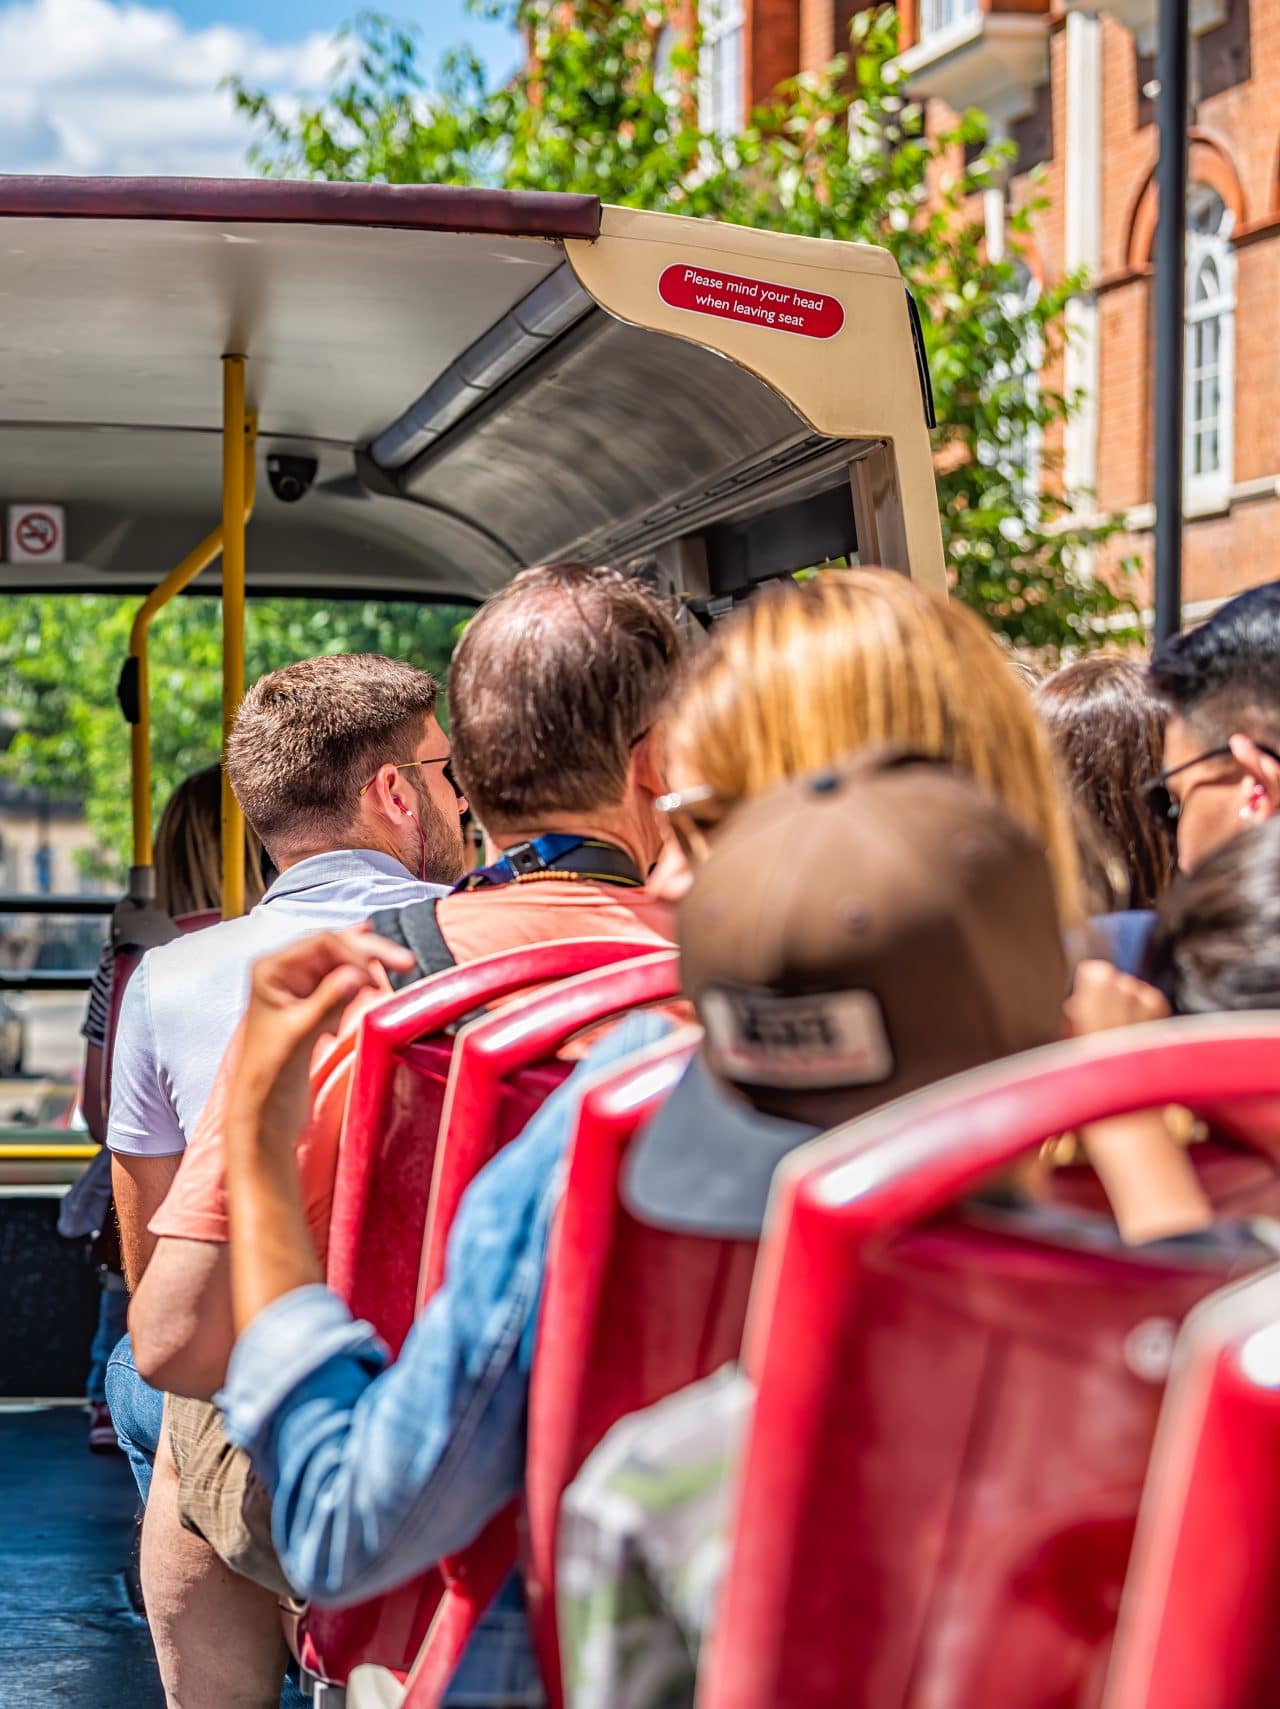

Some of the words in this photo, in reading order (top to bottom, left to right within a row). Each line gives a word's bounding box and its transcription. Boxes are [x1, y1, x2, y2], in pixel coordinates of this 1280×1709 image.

[683, 269, 723, 289] Please
[726, 281, 758, 297] mind
[760, 289, 790, 303] your
[792, 296, 824, 312] head
[695, 293, 730, 311] when
[733, 300, 776, 324] leaving
[778, 313, 805, 328] seat
